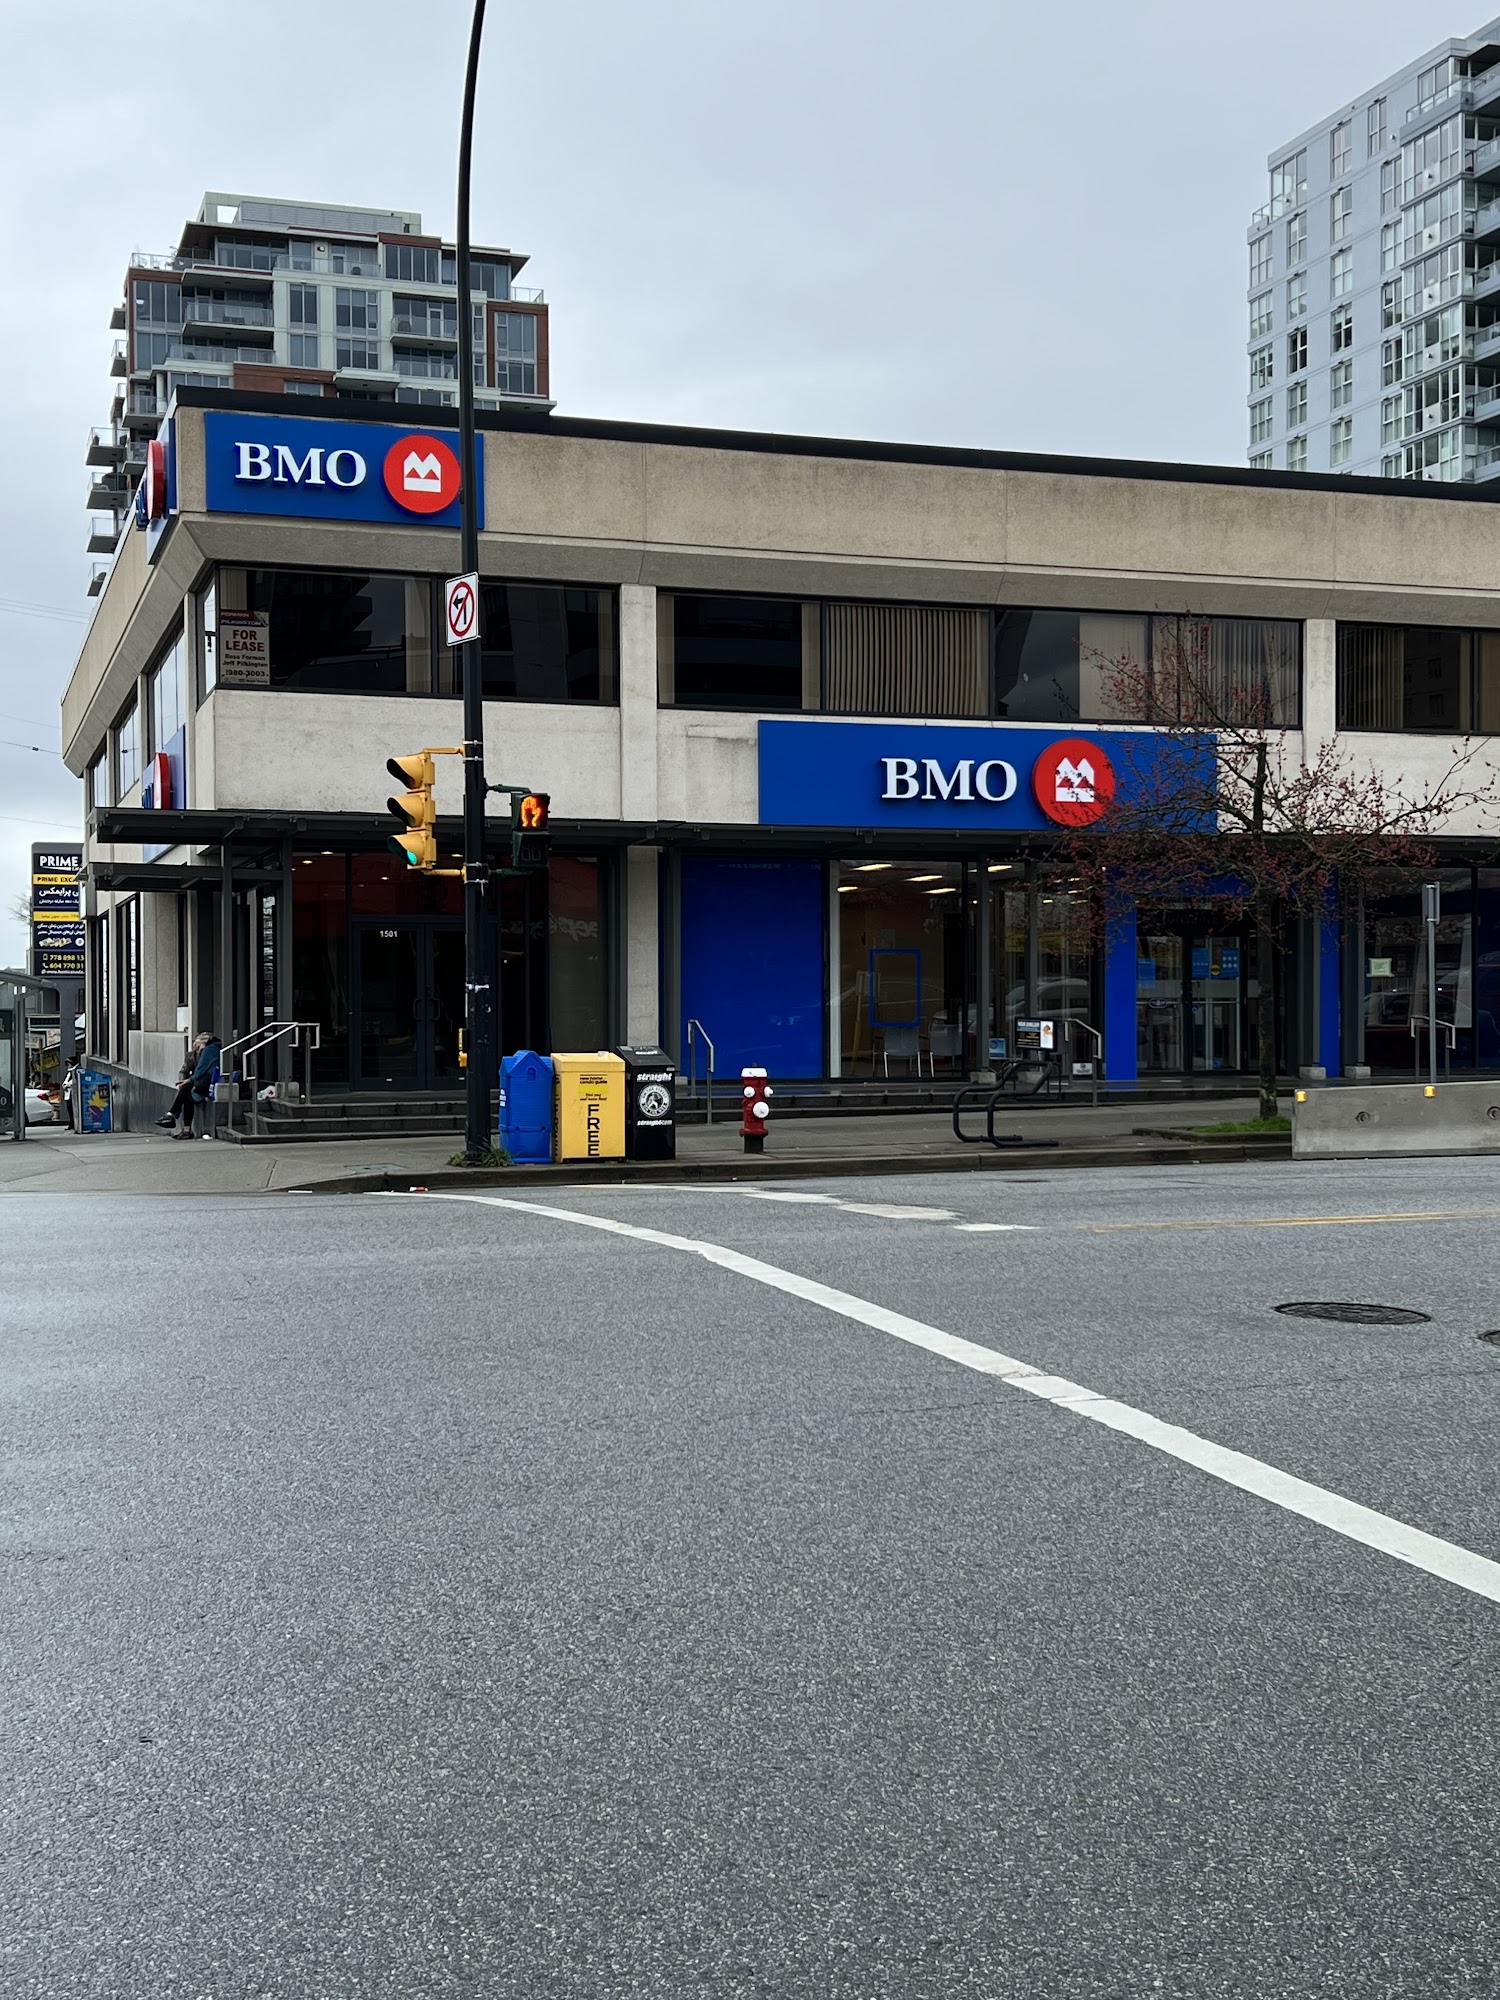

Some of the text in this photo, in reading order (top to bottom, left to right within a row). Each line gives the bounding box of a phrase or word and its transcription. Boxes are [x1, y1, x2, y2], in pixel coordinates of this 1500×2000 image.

[234, 441, 367, 487] BMO
[233, 629, 257, 640] FOR
[226, 640, 265, 652] LEASE
[880, 757, 1018, 802] BMO
[39, 855, 79, 867] PRIME
[379, 930, 398, 938] 1501
[587, 1104, 600, 1156] FREE
